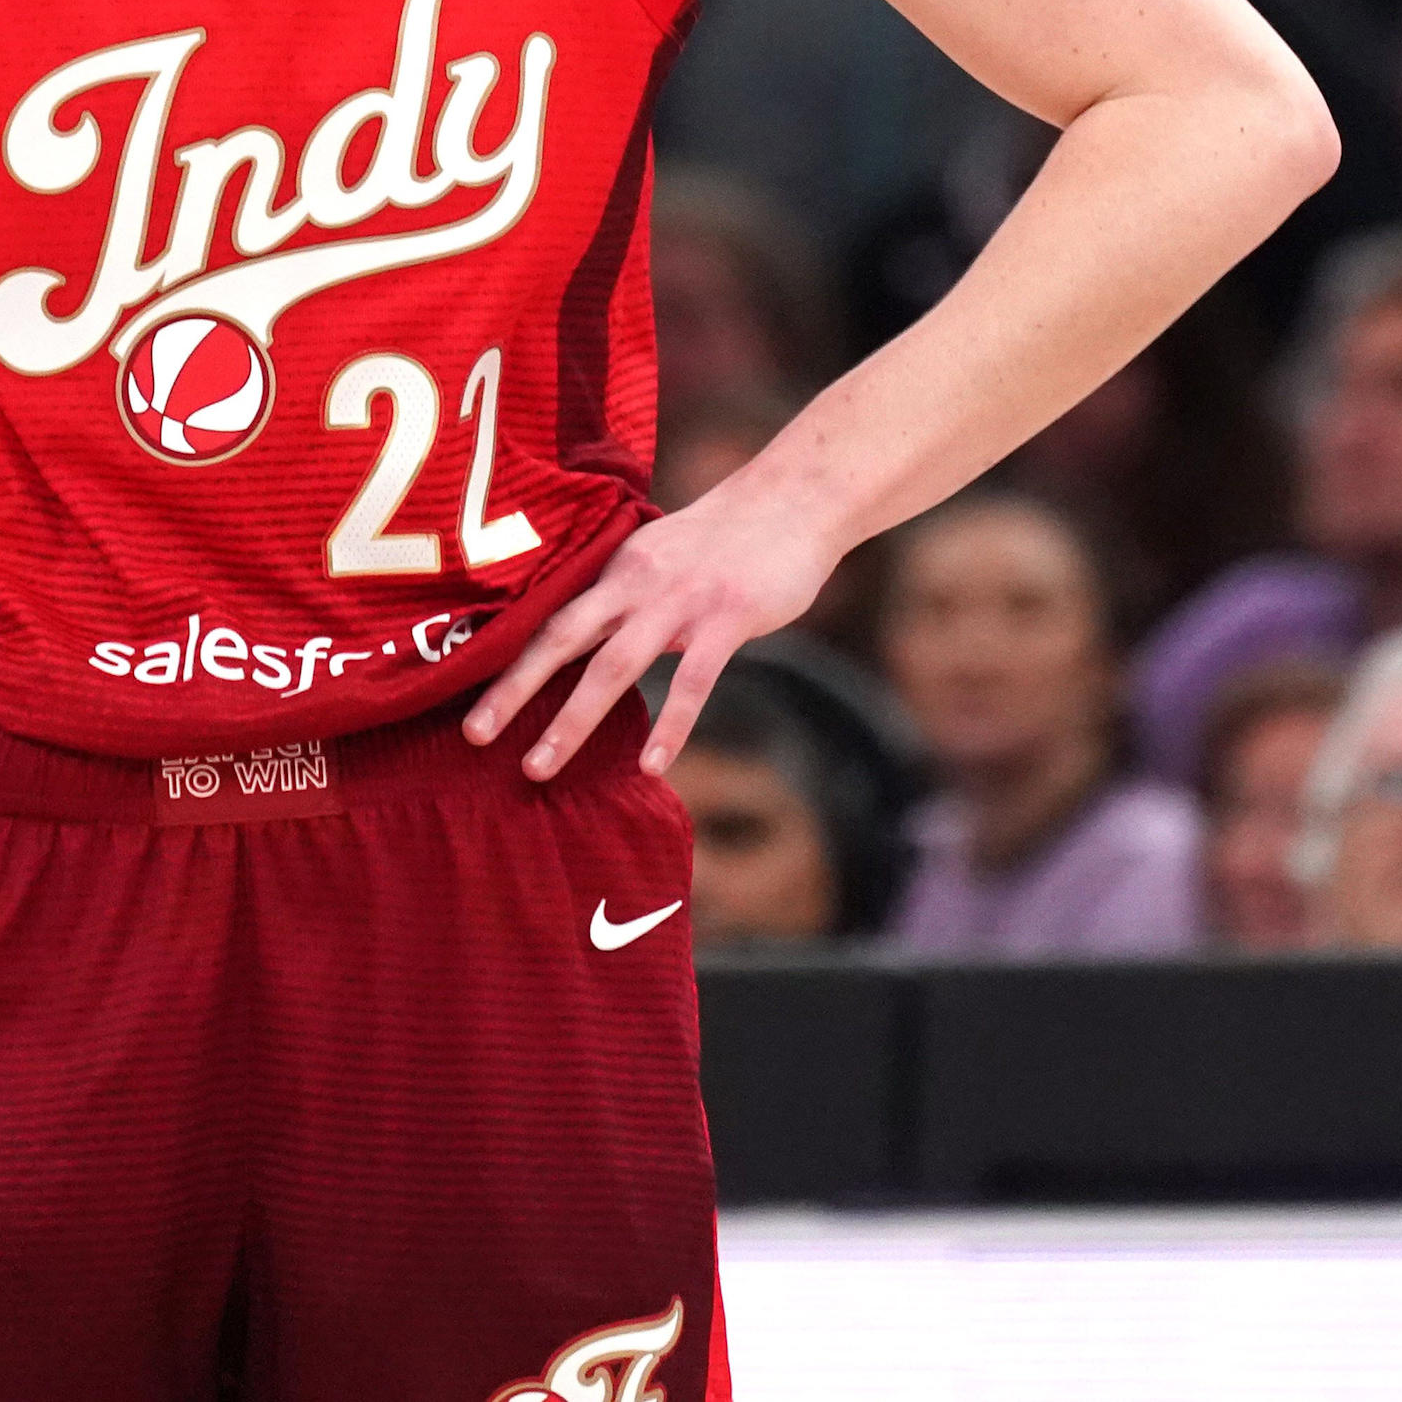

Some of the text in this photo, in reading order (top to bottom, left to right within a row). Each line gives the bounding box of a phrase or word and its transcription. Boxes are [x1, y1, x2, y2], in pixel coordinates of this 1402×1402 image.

[323, 346, 543, 579] 22
[88, 613, 473, 698] salesfc
[162, 755, 328, 799] TO WIN
